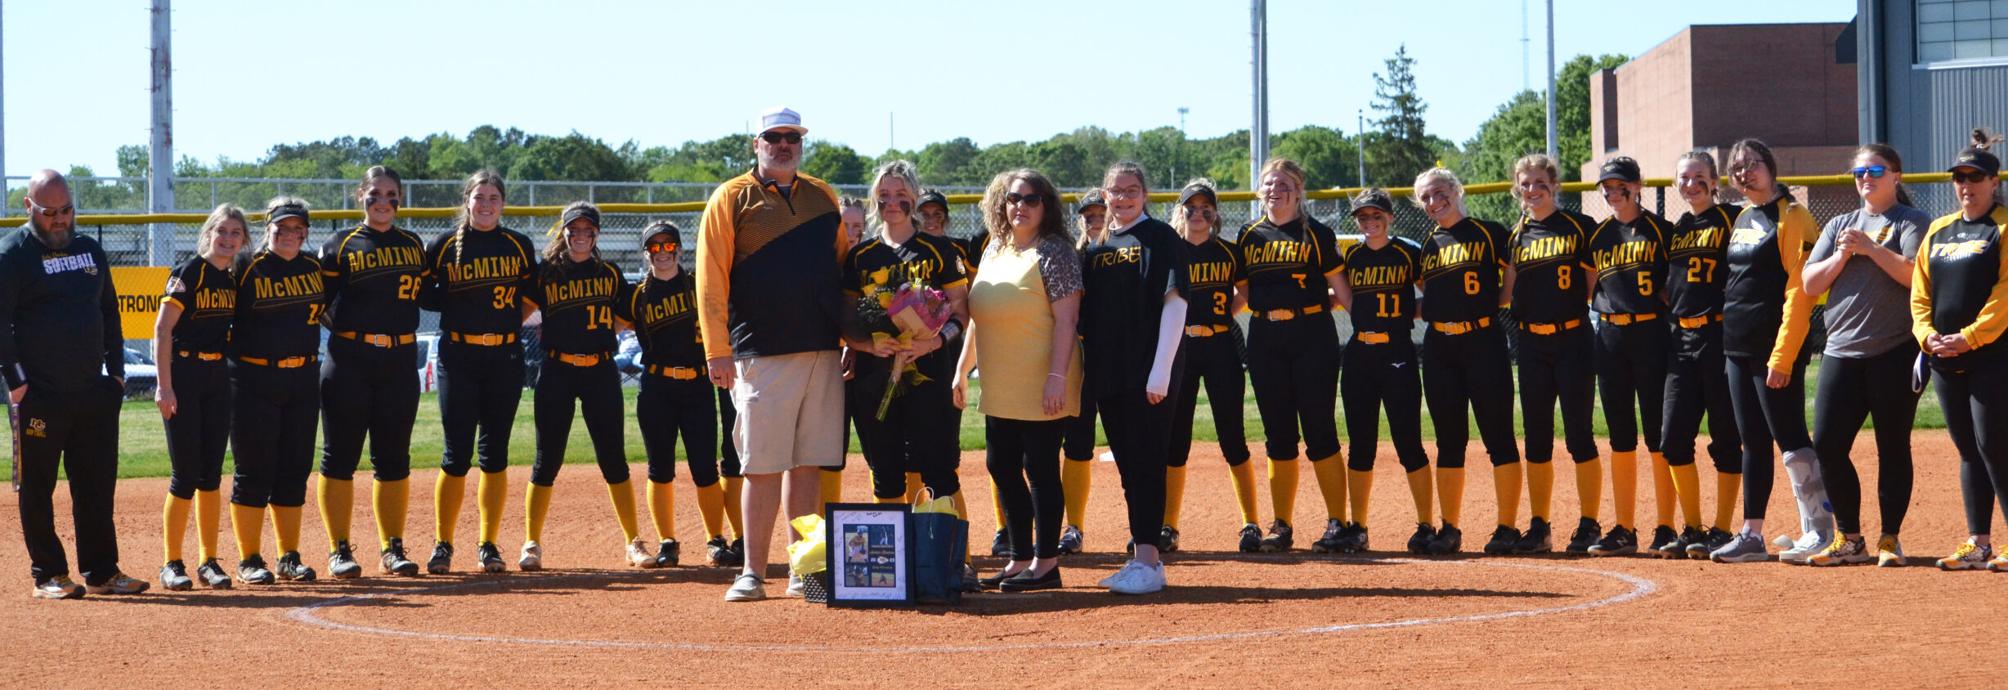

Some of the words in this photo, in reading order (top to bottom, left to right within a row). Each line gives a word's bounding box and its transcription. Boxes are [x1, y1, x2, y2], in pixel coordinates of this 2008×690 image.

[43, 252, 97, 275] SOFTBALL
[348, 246, 421, 273] McMINN
[447, 256, 520, 282] McMINN
[1093, 246, 1141, 271] TRIBE
[1592, 240, 1657, 273] McMINN
[1557, 264, 1571, 290] 8
[1687, 256, 1717, 284] 27
[545, 277, 613, 305] McMINN
[1464, 271, 1480, 295] 6
[1637, 271, 1653, 297] 5
[493, 285, 516, 310] 34
[1213, 291, 1227, 315] 3
[1376, 293, 1402, 317] 11
[586, 305, 613, 330] 14
